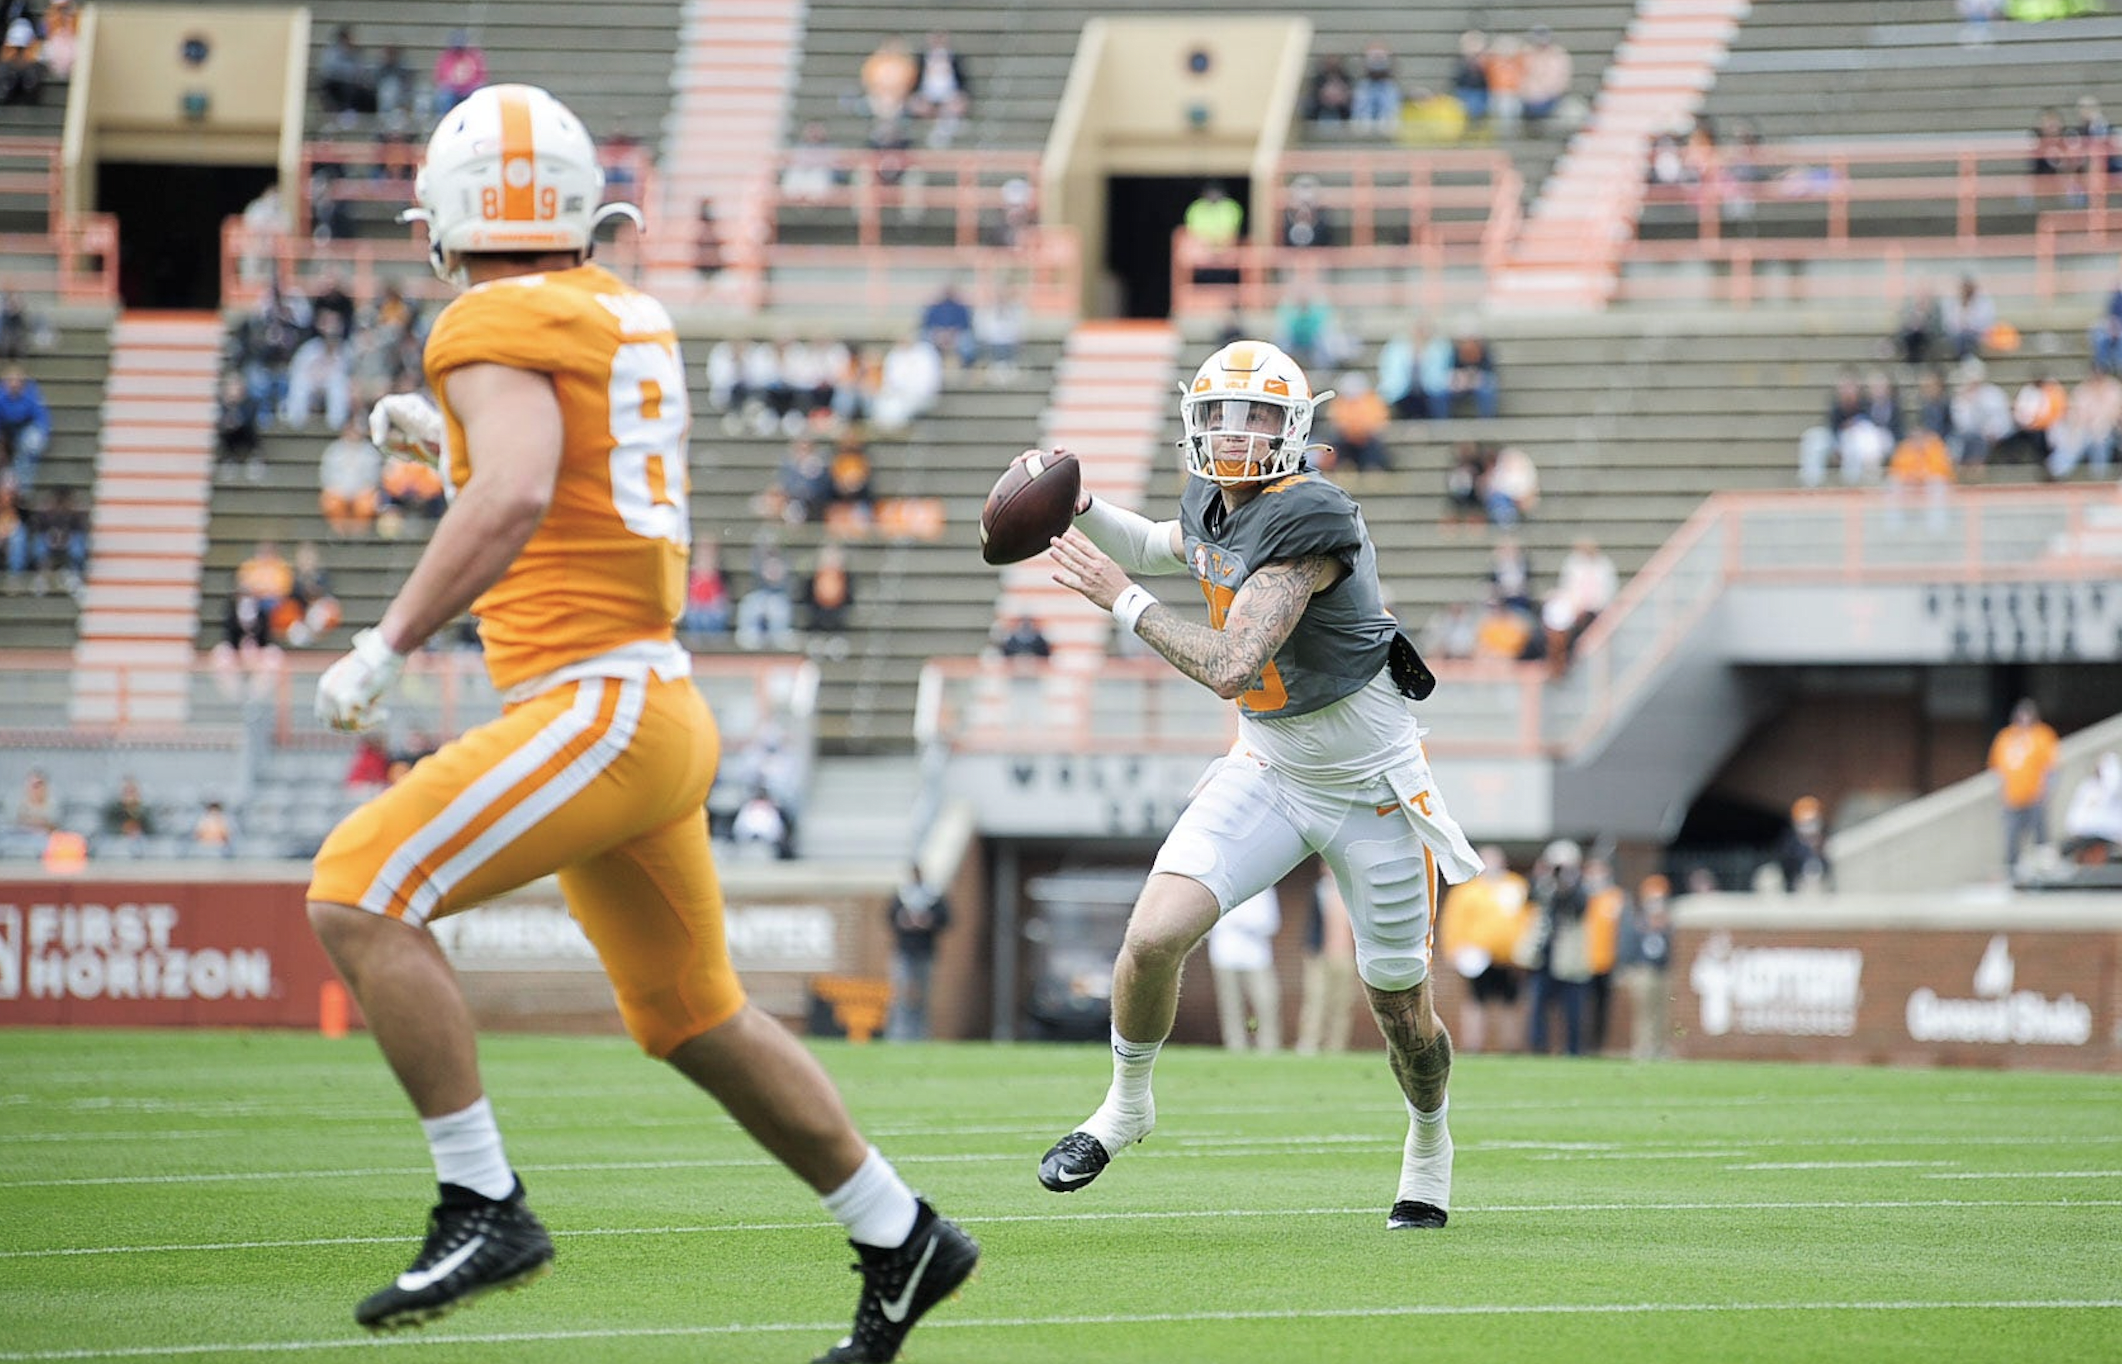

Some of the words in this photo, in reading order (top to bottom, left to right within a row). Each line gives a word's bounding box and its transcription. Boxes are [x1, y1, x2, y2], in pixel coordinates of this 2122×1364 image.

[481, 187, 498, 221] 8
[540, 187, 557, 221] 9
[607, 341, 692, 544] 8
[1409, 789, 1432, 817] T
[28, 902, 178, 950] FIRST
[28, 946, 272, 999] HORIZON
